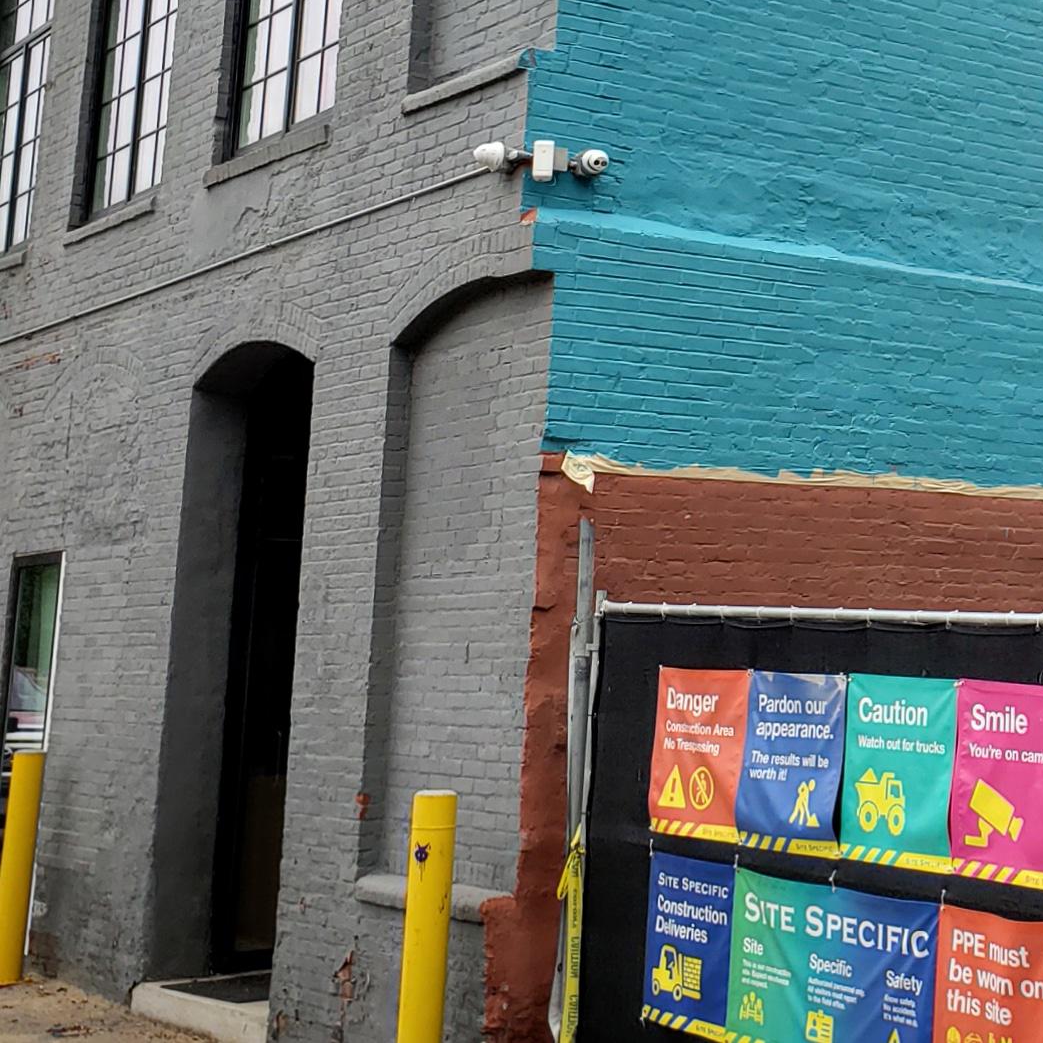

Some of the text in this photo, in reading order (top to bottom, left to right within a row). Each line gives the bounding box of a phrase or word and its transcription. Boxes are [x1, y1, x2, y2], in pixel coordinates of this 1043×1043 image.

[666, 687, 719, 717] Danger
[758, 694, 828, 715] Pardon our
[859, 697, 928, 727] Caution
[713, 723, 734, 737] Area
[756, 720, 834, 741] appearance.
[971, 703, 1028, 734] Smile
[663, 737, 676, 750] No
[858, 734, 946, 755] Watch out for trucks
[969, 742, 1002, 760] You're
[1005, 749, 1019, 762] on
[751, 749, 829, 768] The results will be
[749, 767, 788, 781] worth it!
[658, 872, 729, 899] SITE SPECIFIC
[657, 894, 728, 925] Construction
[655, 915, 708, 944] Deliveries
[744, 892, 930, 958] SITE SPECIFIC
[743, 937, 764, 956] Site
[952, 928, 1030, 968] PPE must
[809, 953, 853, 977] Specific
[949, 958, 973, 984] be
[977, 968, 1013, 996] worn
[886, 970, 923, 996] Safety
[946, 989, 1012, 1026] this site
